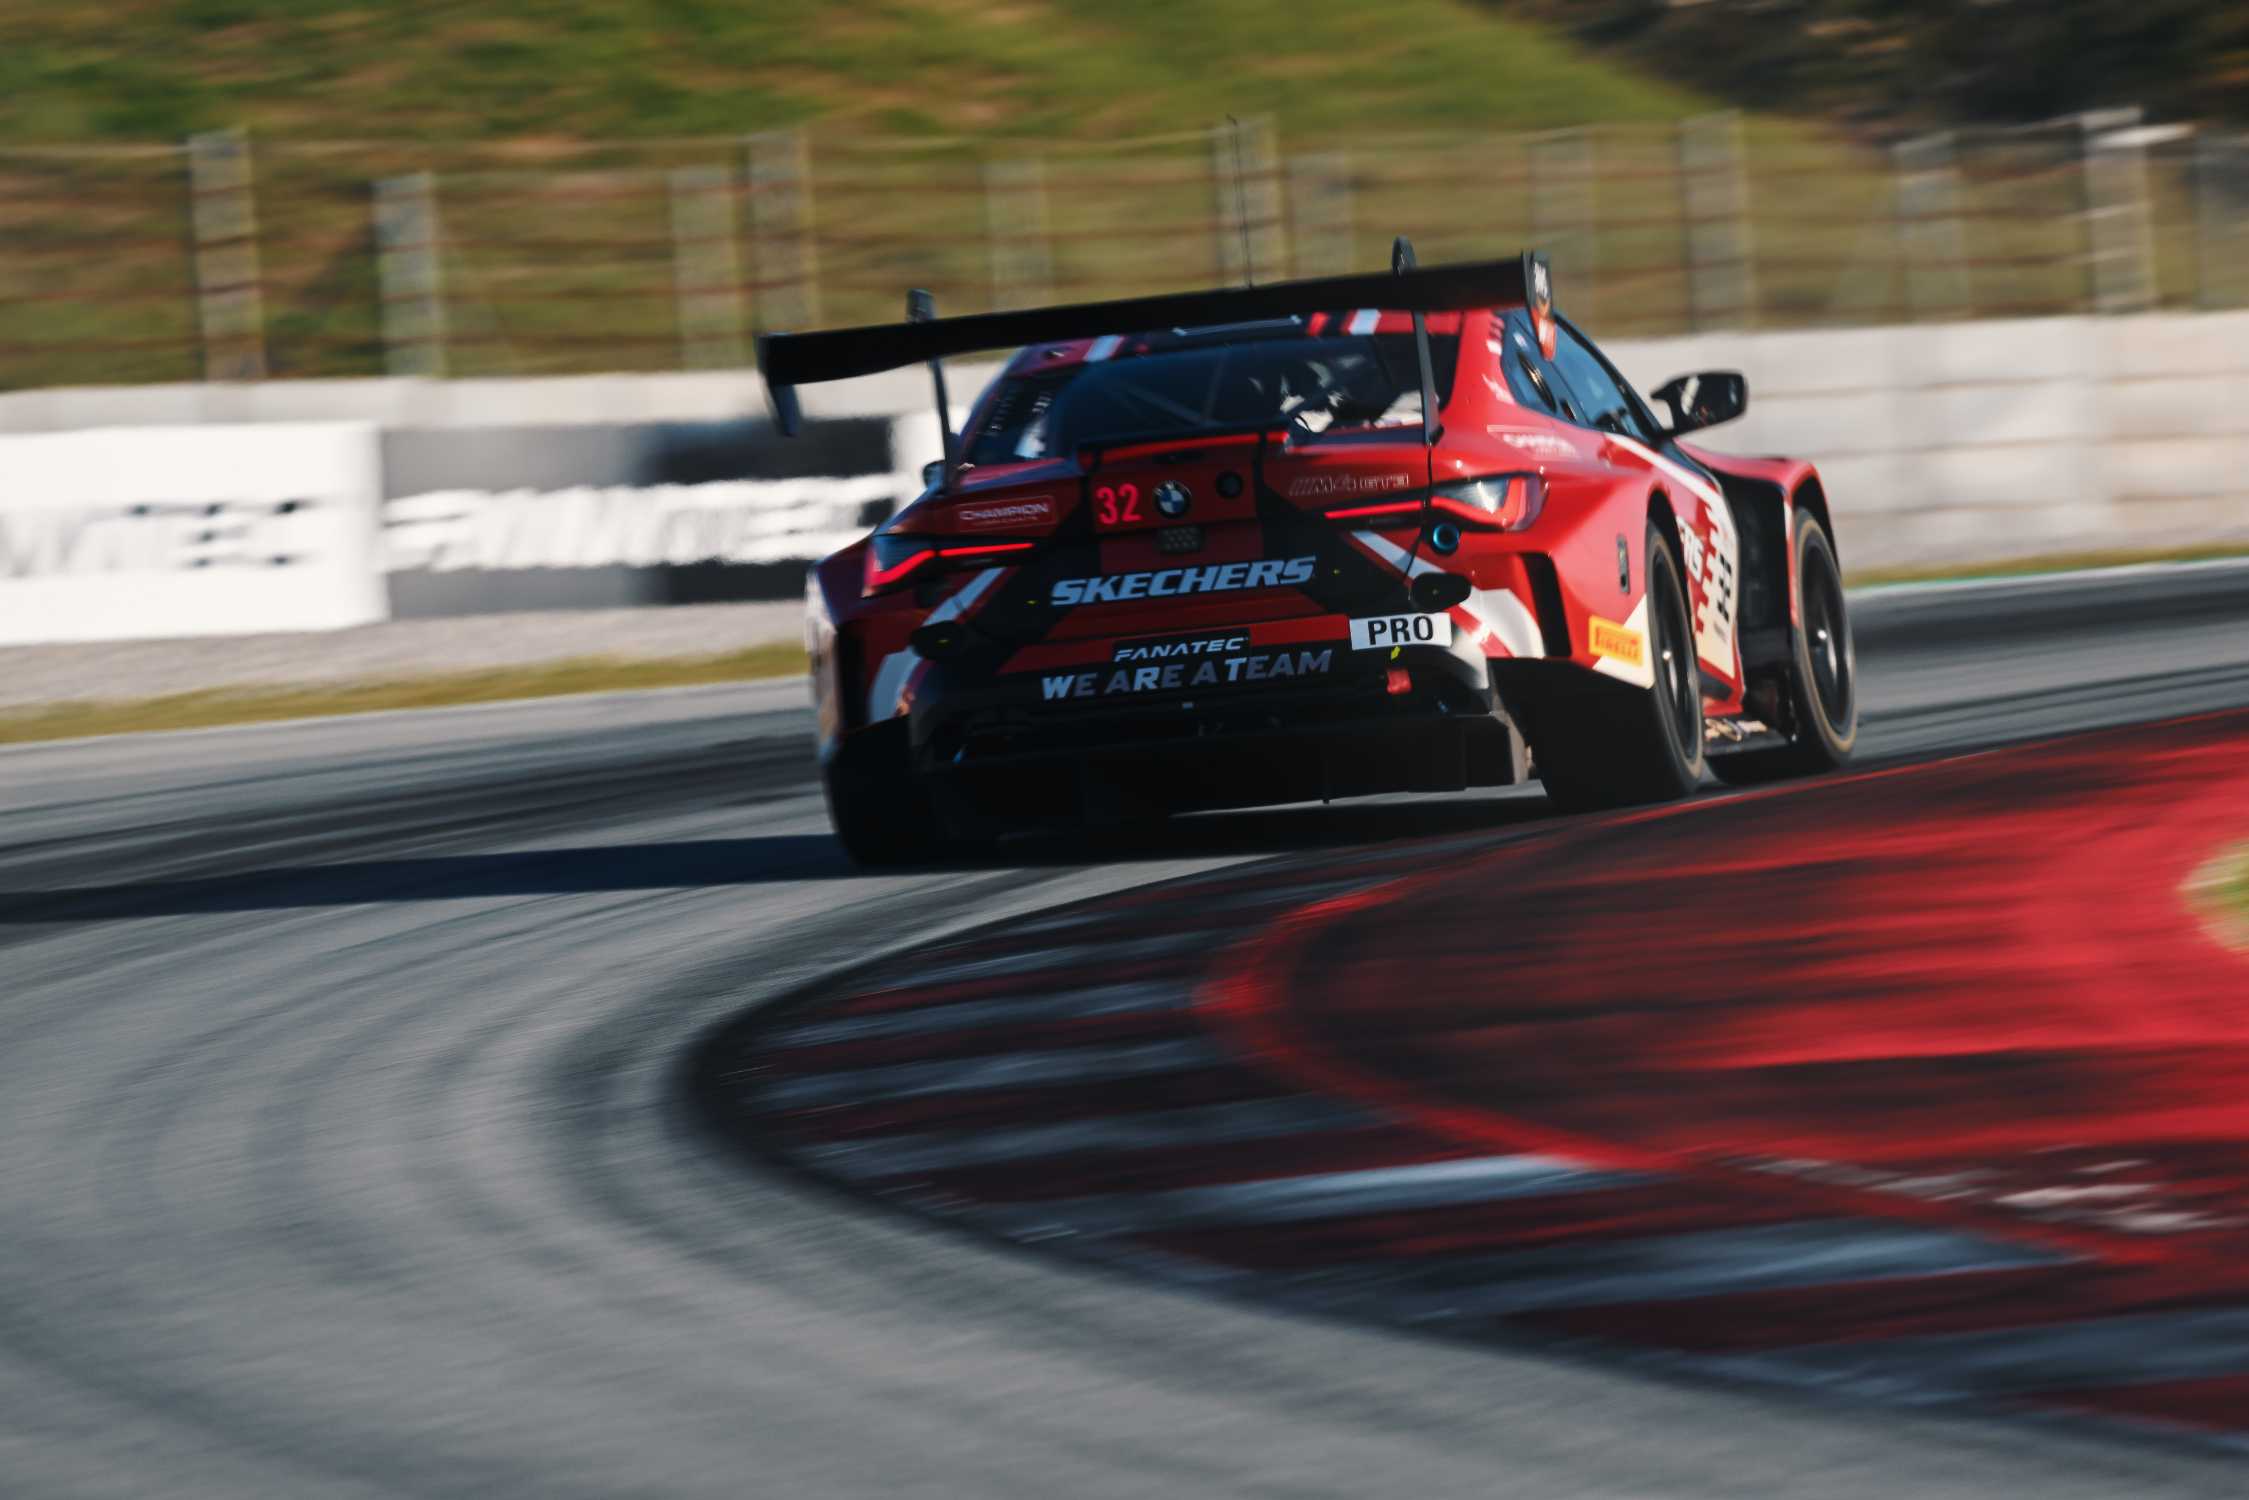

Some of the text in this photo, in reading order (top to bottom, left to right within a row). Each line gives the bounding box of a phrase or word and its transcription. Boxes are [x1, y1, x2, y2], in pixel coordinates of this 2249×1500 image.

[959, 502, 1049, 520] CHAMPION
[1096, 482, 1142, 525] 32
[1050, 555, 1317, 606] SKECHERS
[1112, 636, 1247, 662] FANATEC
[1367, 615, 1434, 646] PRO
[1041, 672, 1098, 700] WE
[1103, 663, 1184, 694] ARE
[1224, 649, 1333, 682] TEAM
